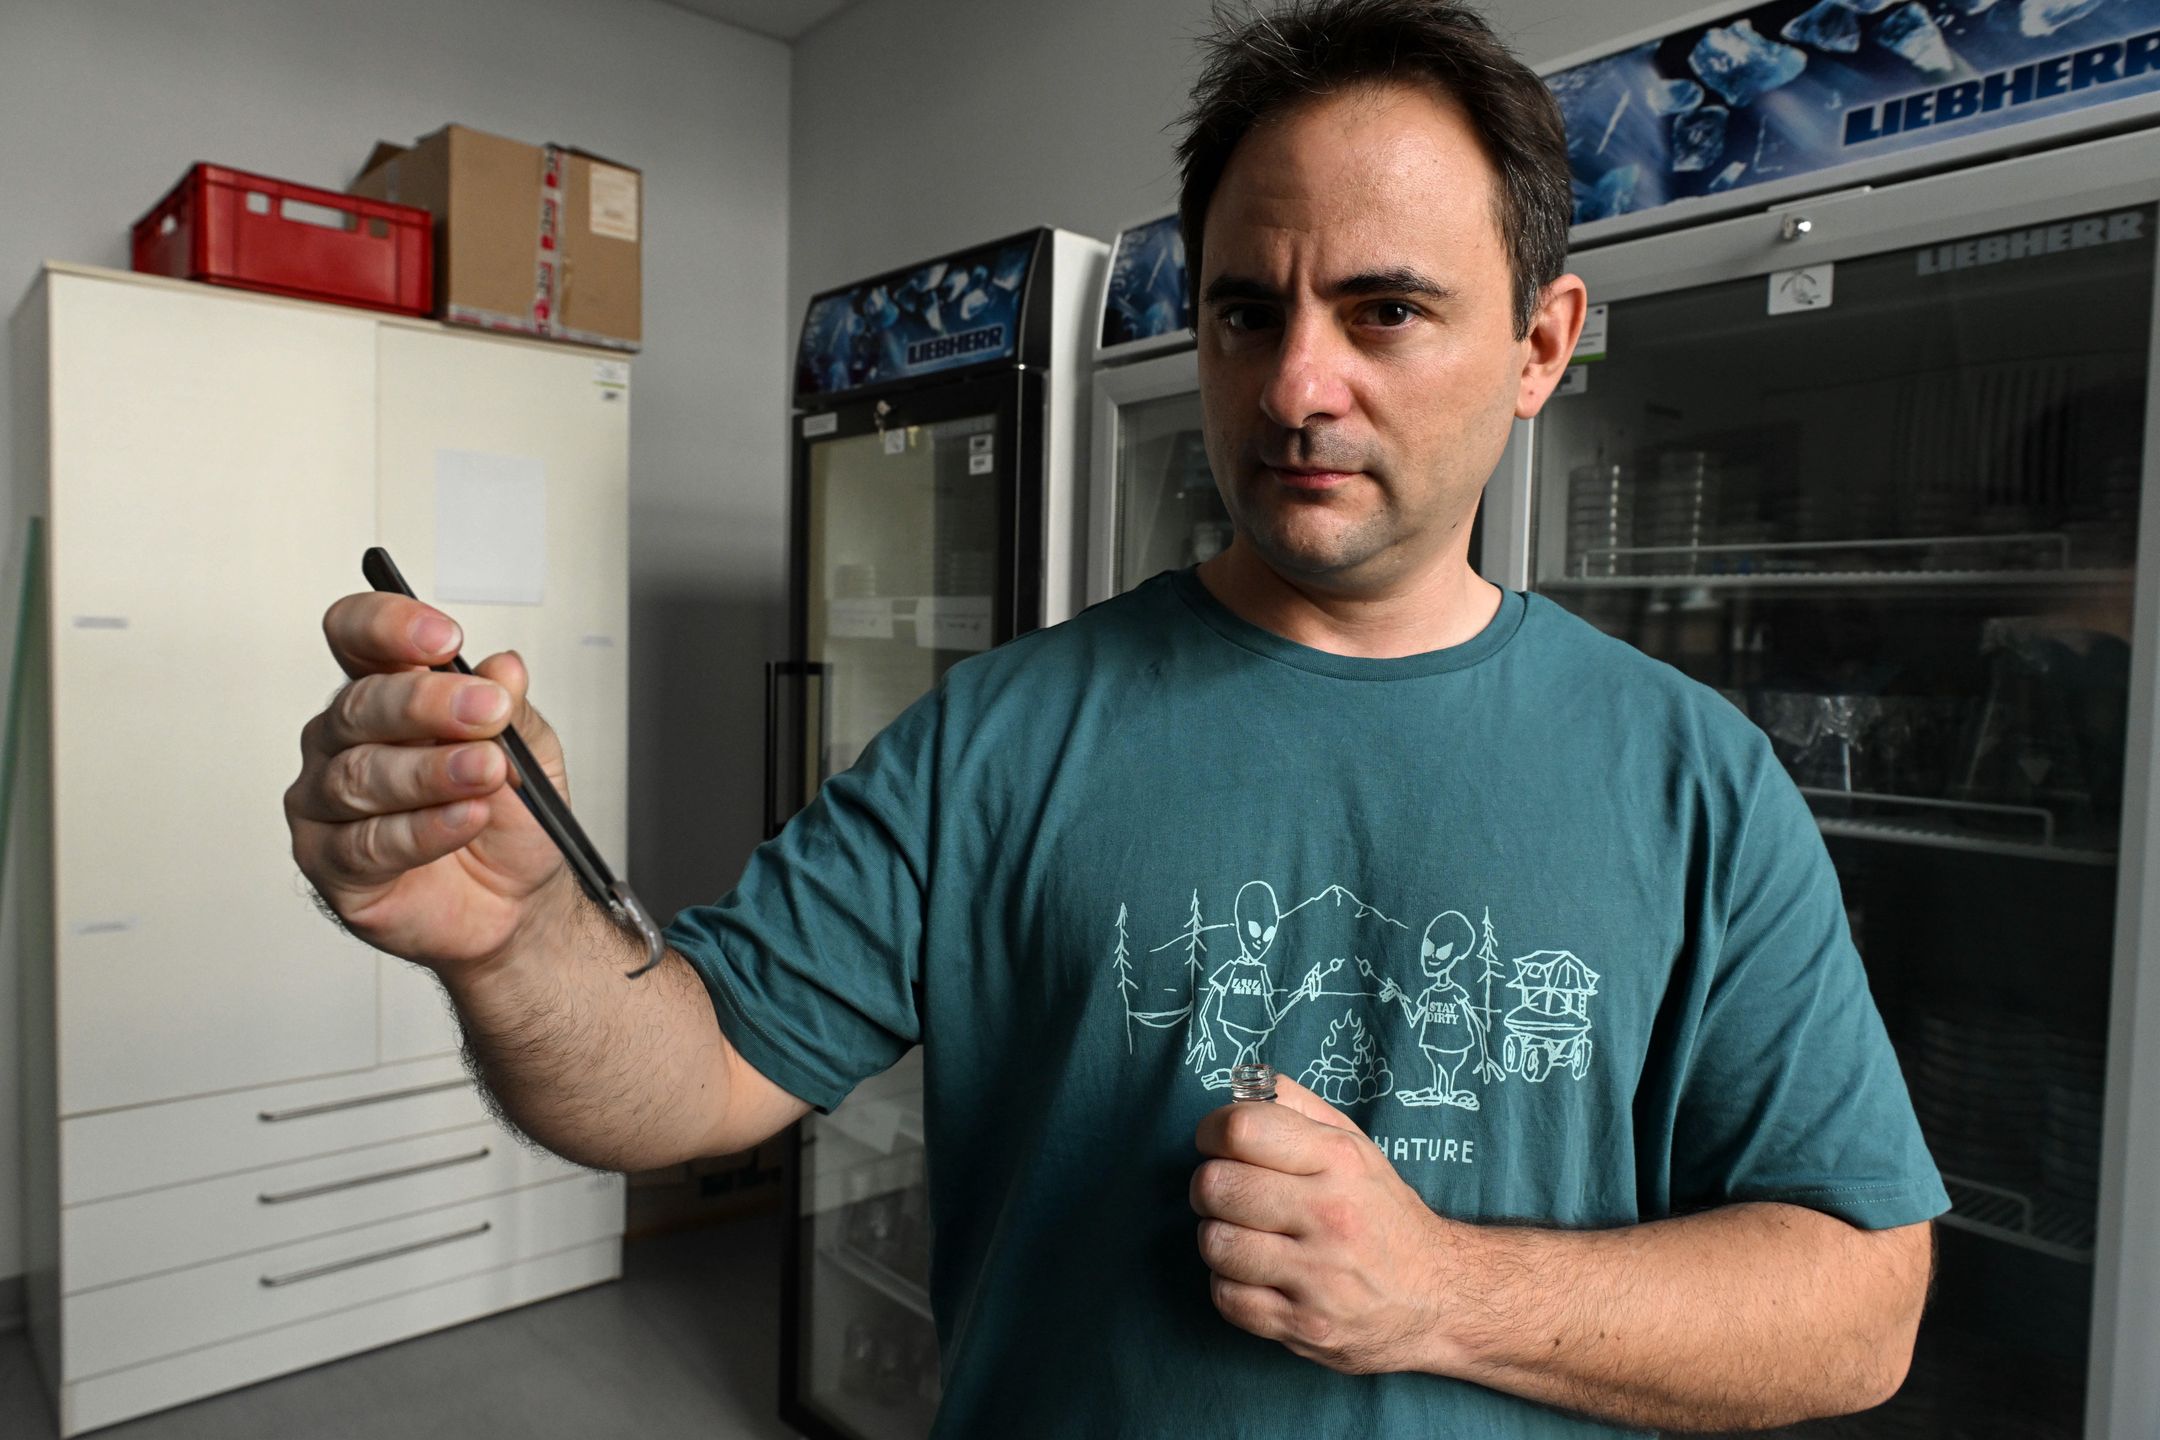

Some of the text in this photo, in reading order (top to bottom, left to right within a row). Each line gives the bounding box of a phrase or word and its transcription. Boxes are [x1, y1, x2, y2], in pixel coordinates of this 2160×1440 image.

[1844, 30, 2160, 146] LIEBHERR
[1917, 211, 2145, 276] LIEBHERR
[907, 326, 1003, 365] LIEBHERR
[1426, 1012, 1459, 1025] DIRTY
[1429, 1001, 1457, 1014] STAY
